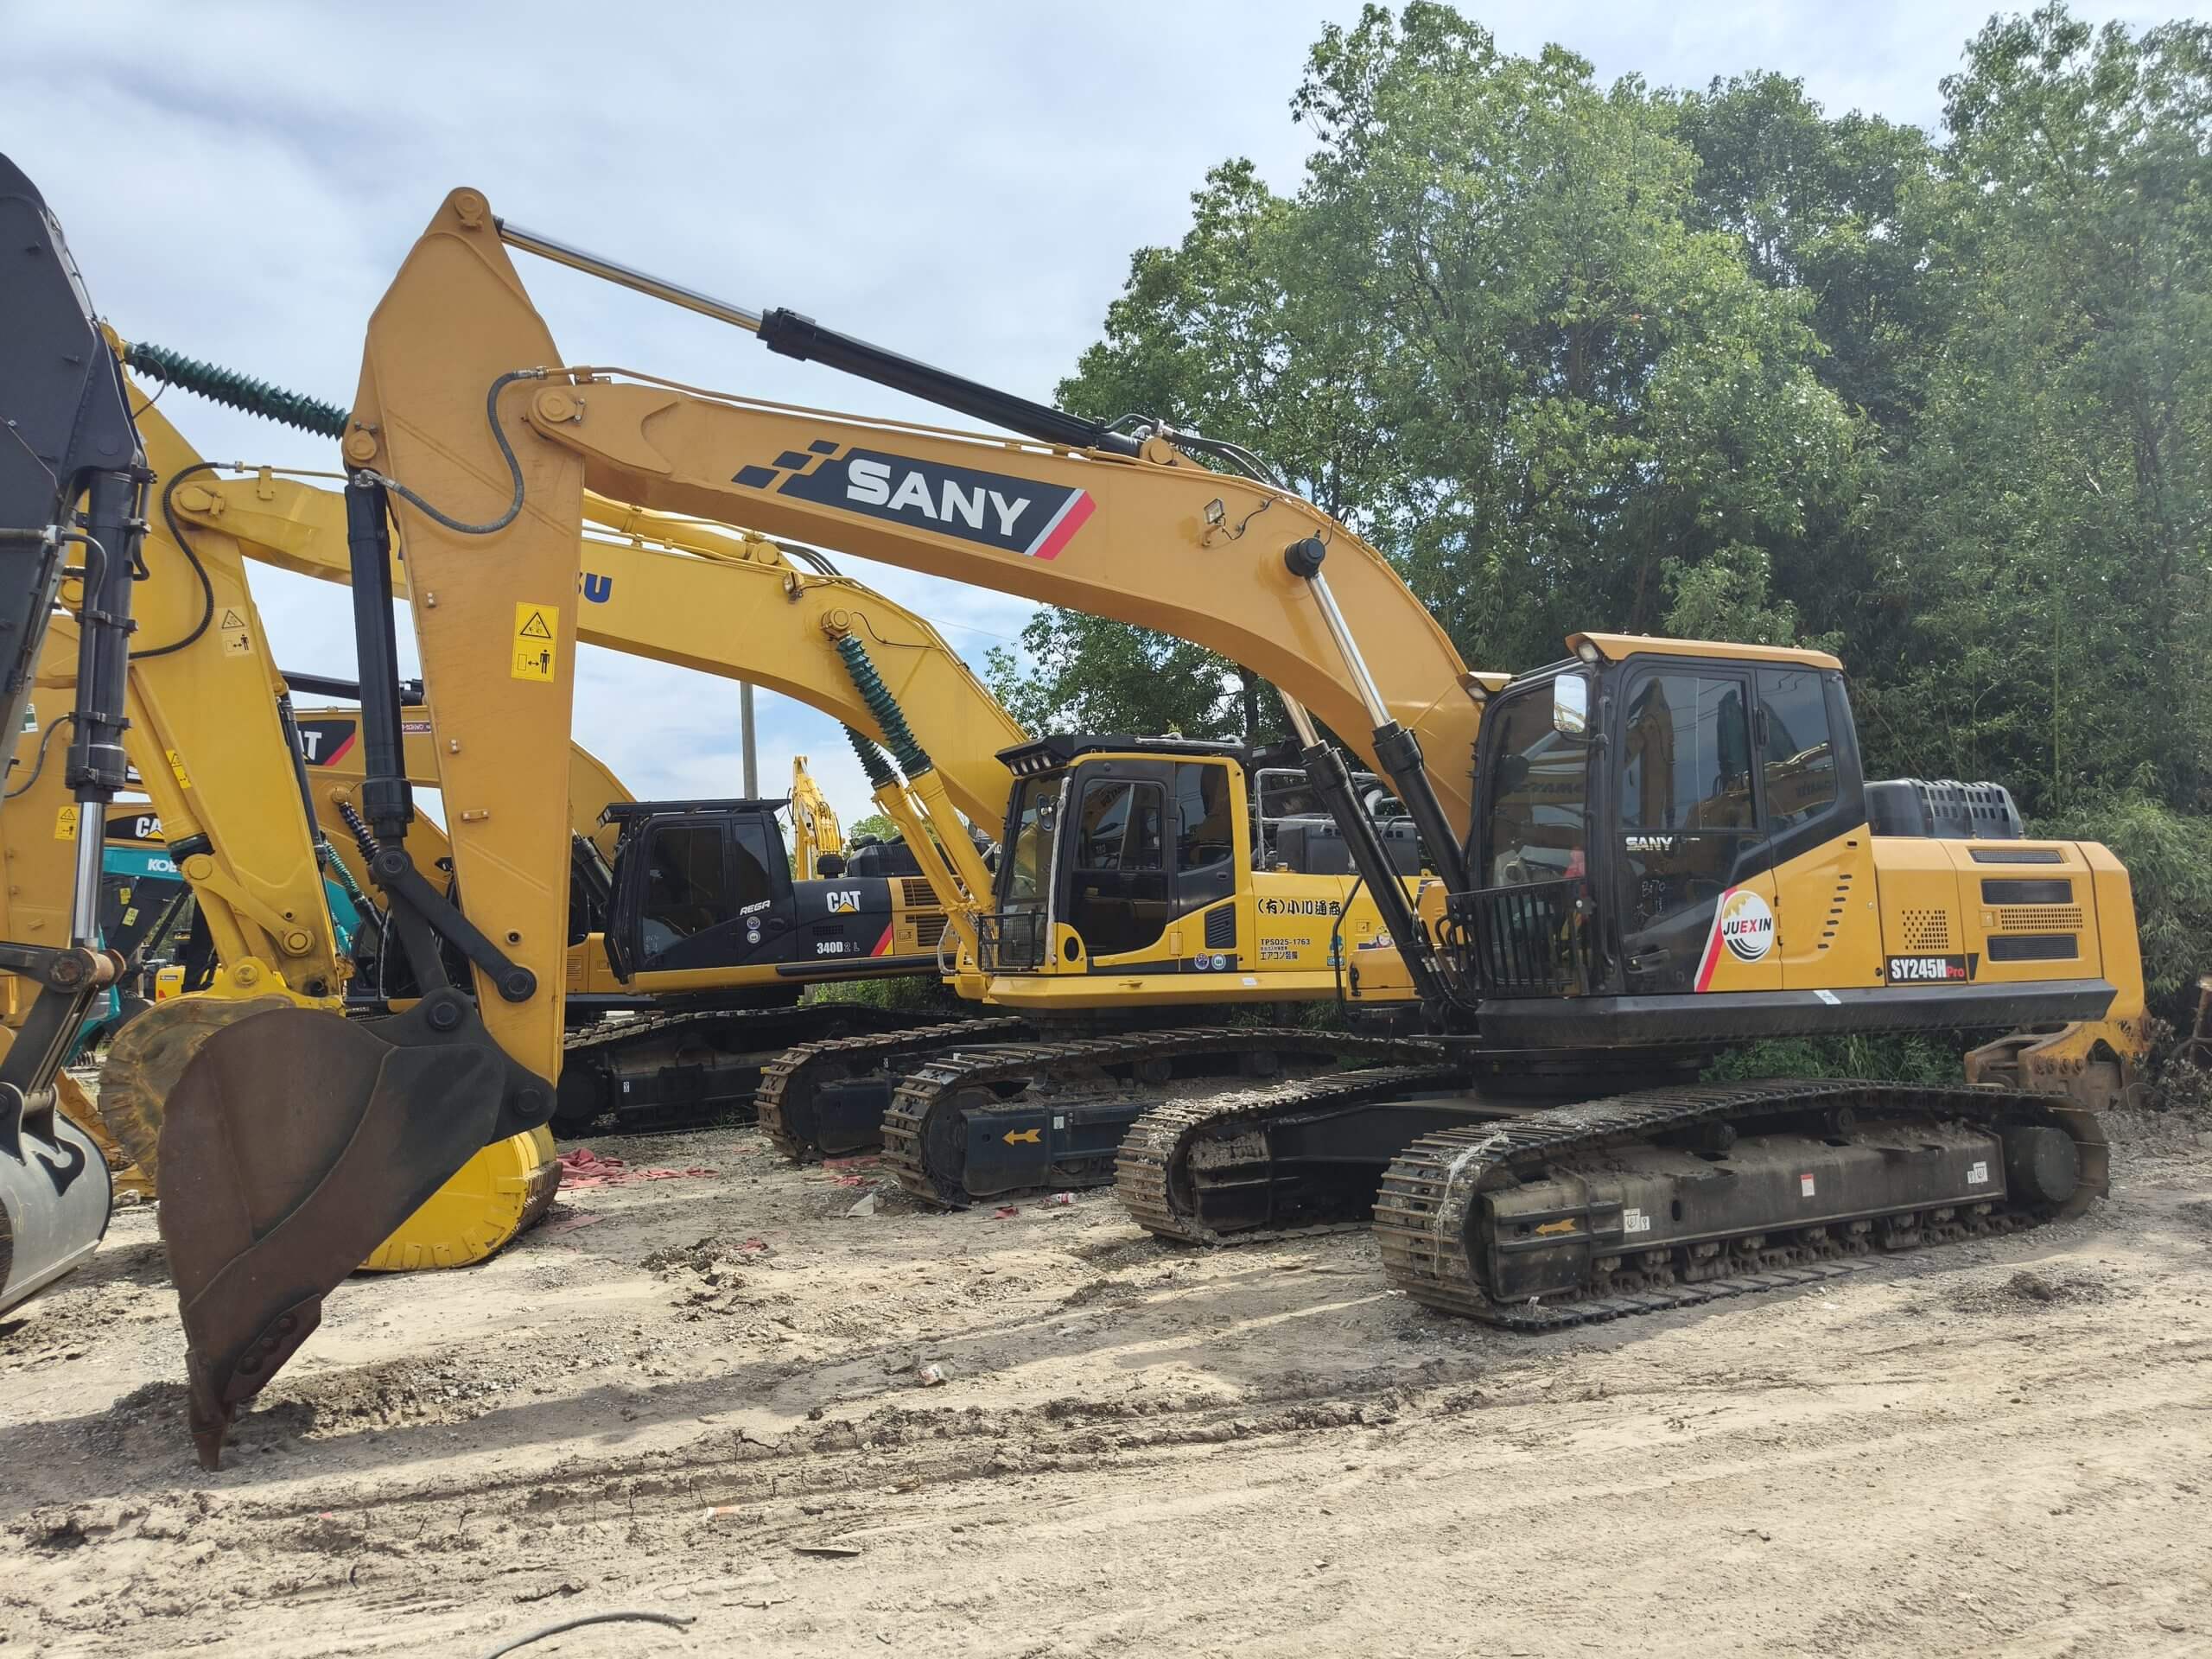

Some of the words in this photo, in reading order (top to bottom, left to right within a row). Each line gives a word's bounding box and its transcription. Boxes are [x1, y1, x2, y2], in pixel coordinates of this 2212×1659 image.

[847, 459, 1031, 537] SANY
[1626, 836, 1672, 851] SANY
[826, 890, 861, 912] CAT
[1723, 918, 1771, 935] JUEXIN
